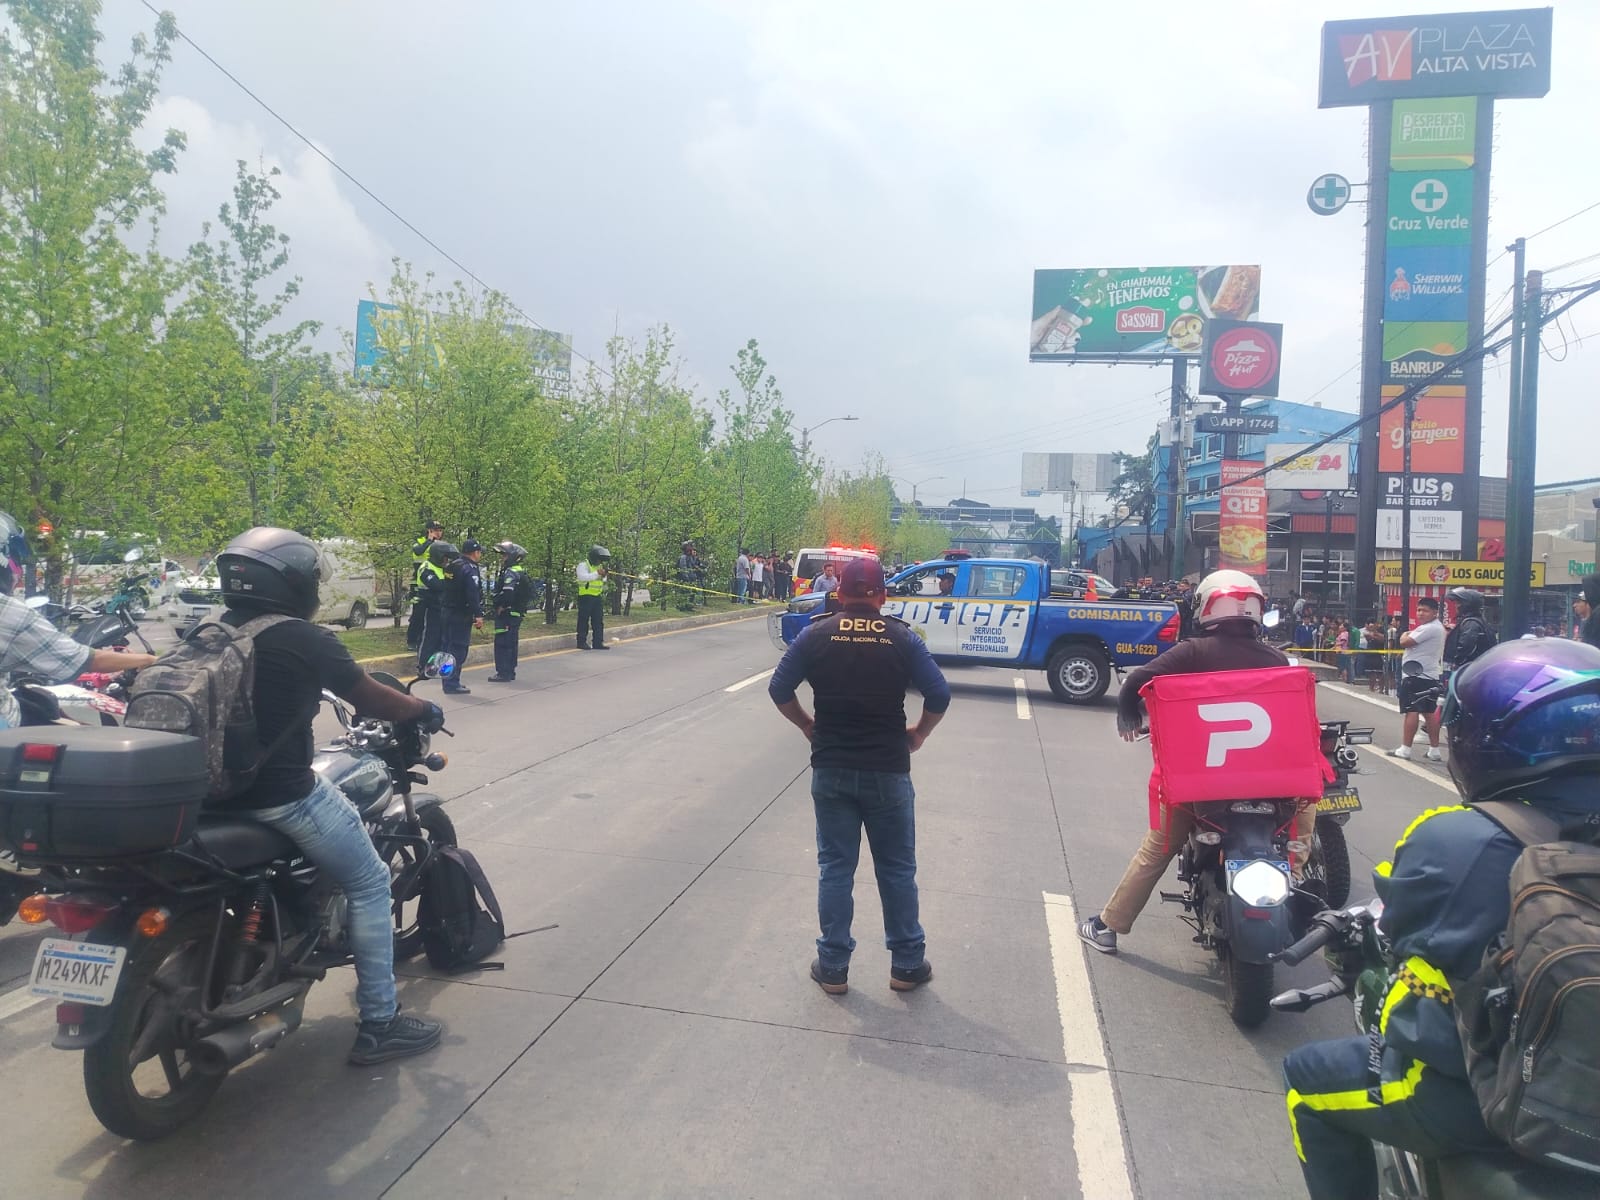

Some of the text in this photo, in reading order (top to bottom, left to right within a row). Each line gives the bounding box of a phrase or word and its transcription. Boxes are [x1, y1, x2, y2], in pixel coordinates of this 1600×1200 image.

[1419, 23, 1536, 54] PLAZA
[1417, 52, 1536, 75] ALTA VISTA
[1403, 112, 1464, 127] DESPENSA
[1403, 126, 1464, 142] FAMILIAR
[1389, 213, 1469, 231] Cruz Verde
[1106, 275, 1172, 291] EN GUATEMALA
[1108, 286, 1171, 308] TENEMOS
[1224, 352, 1261, 367] Pizza
[1229, 364, 1258, 376] Hut
[1220, 417, 1275, 428] APP 1744
[1390, 426, 1458, 449] ganjero
[1227, 496, 1260, 514] Q15
[1452, 567, 1471, 579] LOS
[1068, 608, 1162, 623] COMISARIA 16
[840, 618, 886, 632] DEIC
[974, 627, 1002, 635] SERVICIO
[969, 635, 1006, 644] INTEGRIDAD
[1116, 642, 1158, 656] GUA-16228
[1198, 701, 1272, 767] P
[38, 956, 114, 987] M249KXF
